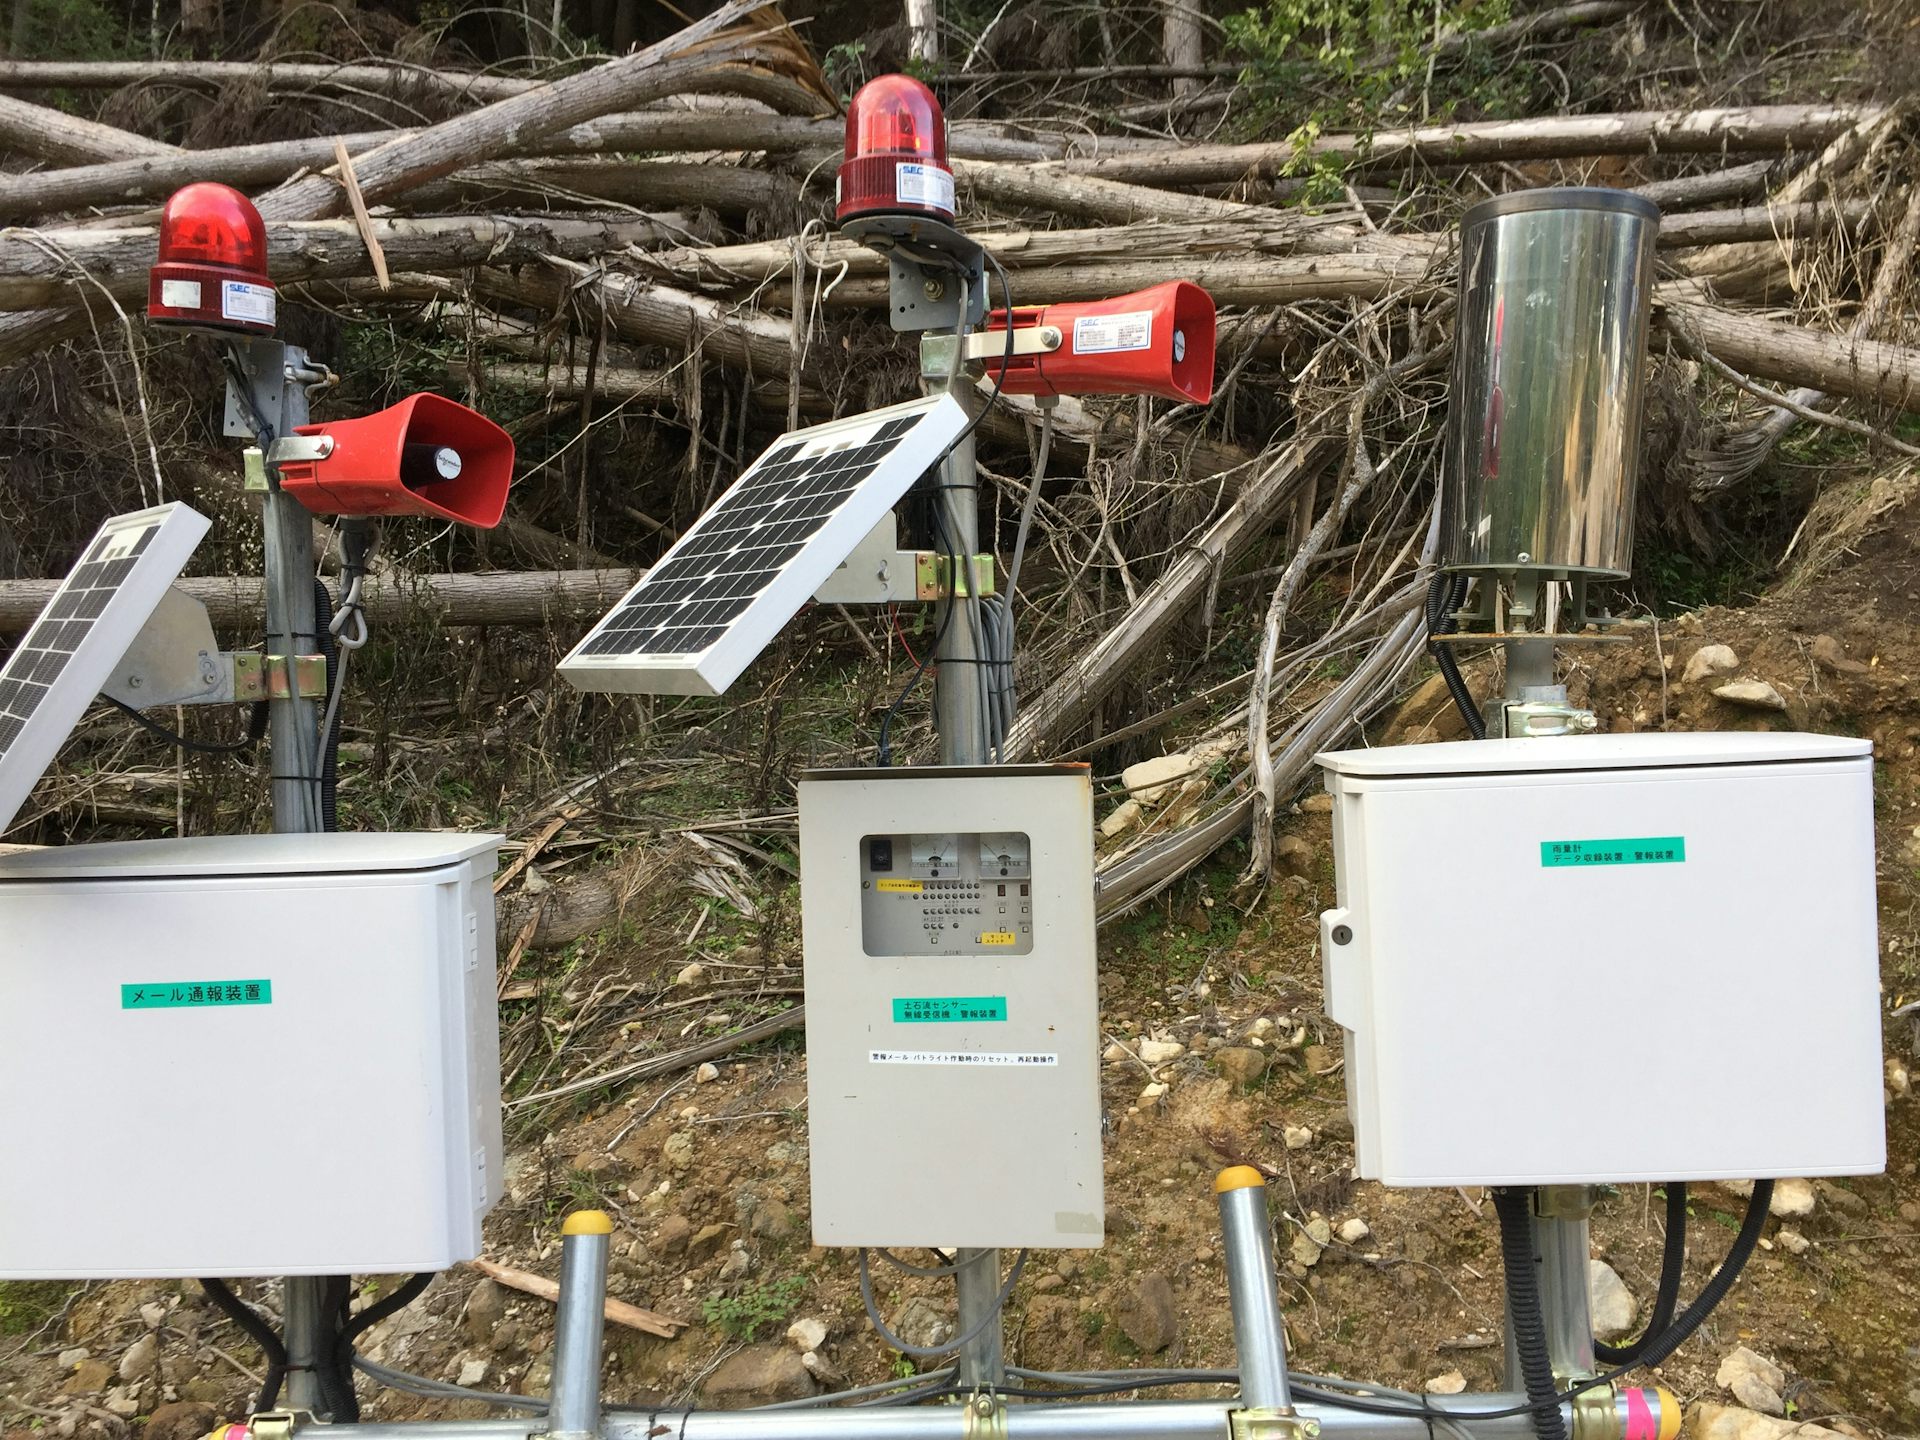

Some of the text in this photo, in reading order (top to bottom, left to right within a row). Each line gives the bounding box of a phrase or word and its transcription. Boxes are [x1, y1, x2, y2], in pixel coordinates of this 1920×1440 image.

[903, 165, 924, 175] SEC
[229, 284, 251, 294] SEC
[1080, 318, 1099, 327] SEC
[1552, 844, 1582, 853] 雨量計
[133, 984, 261, 1003] メール通報装置
[904, 1001, 969, 1010] 土石流センサー
